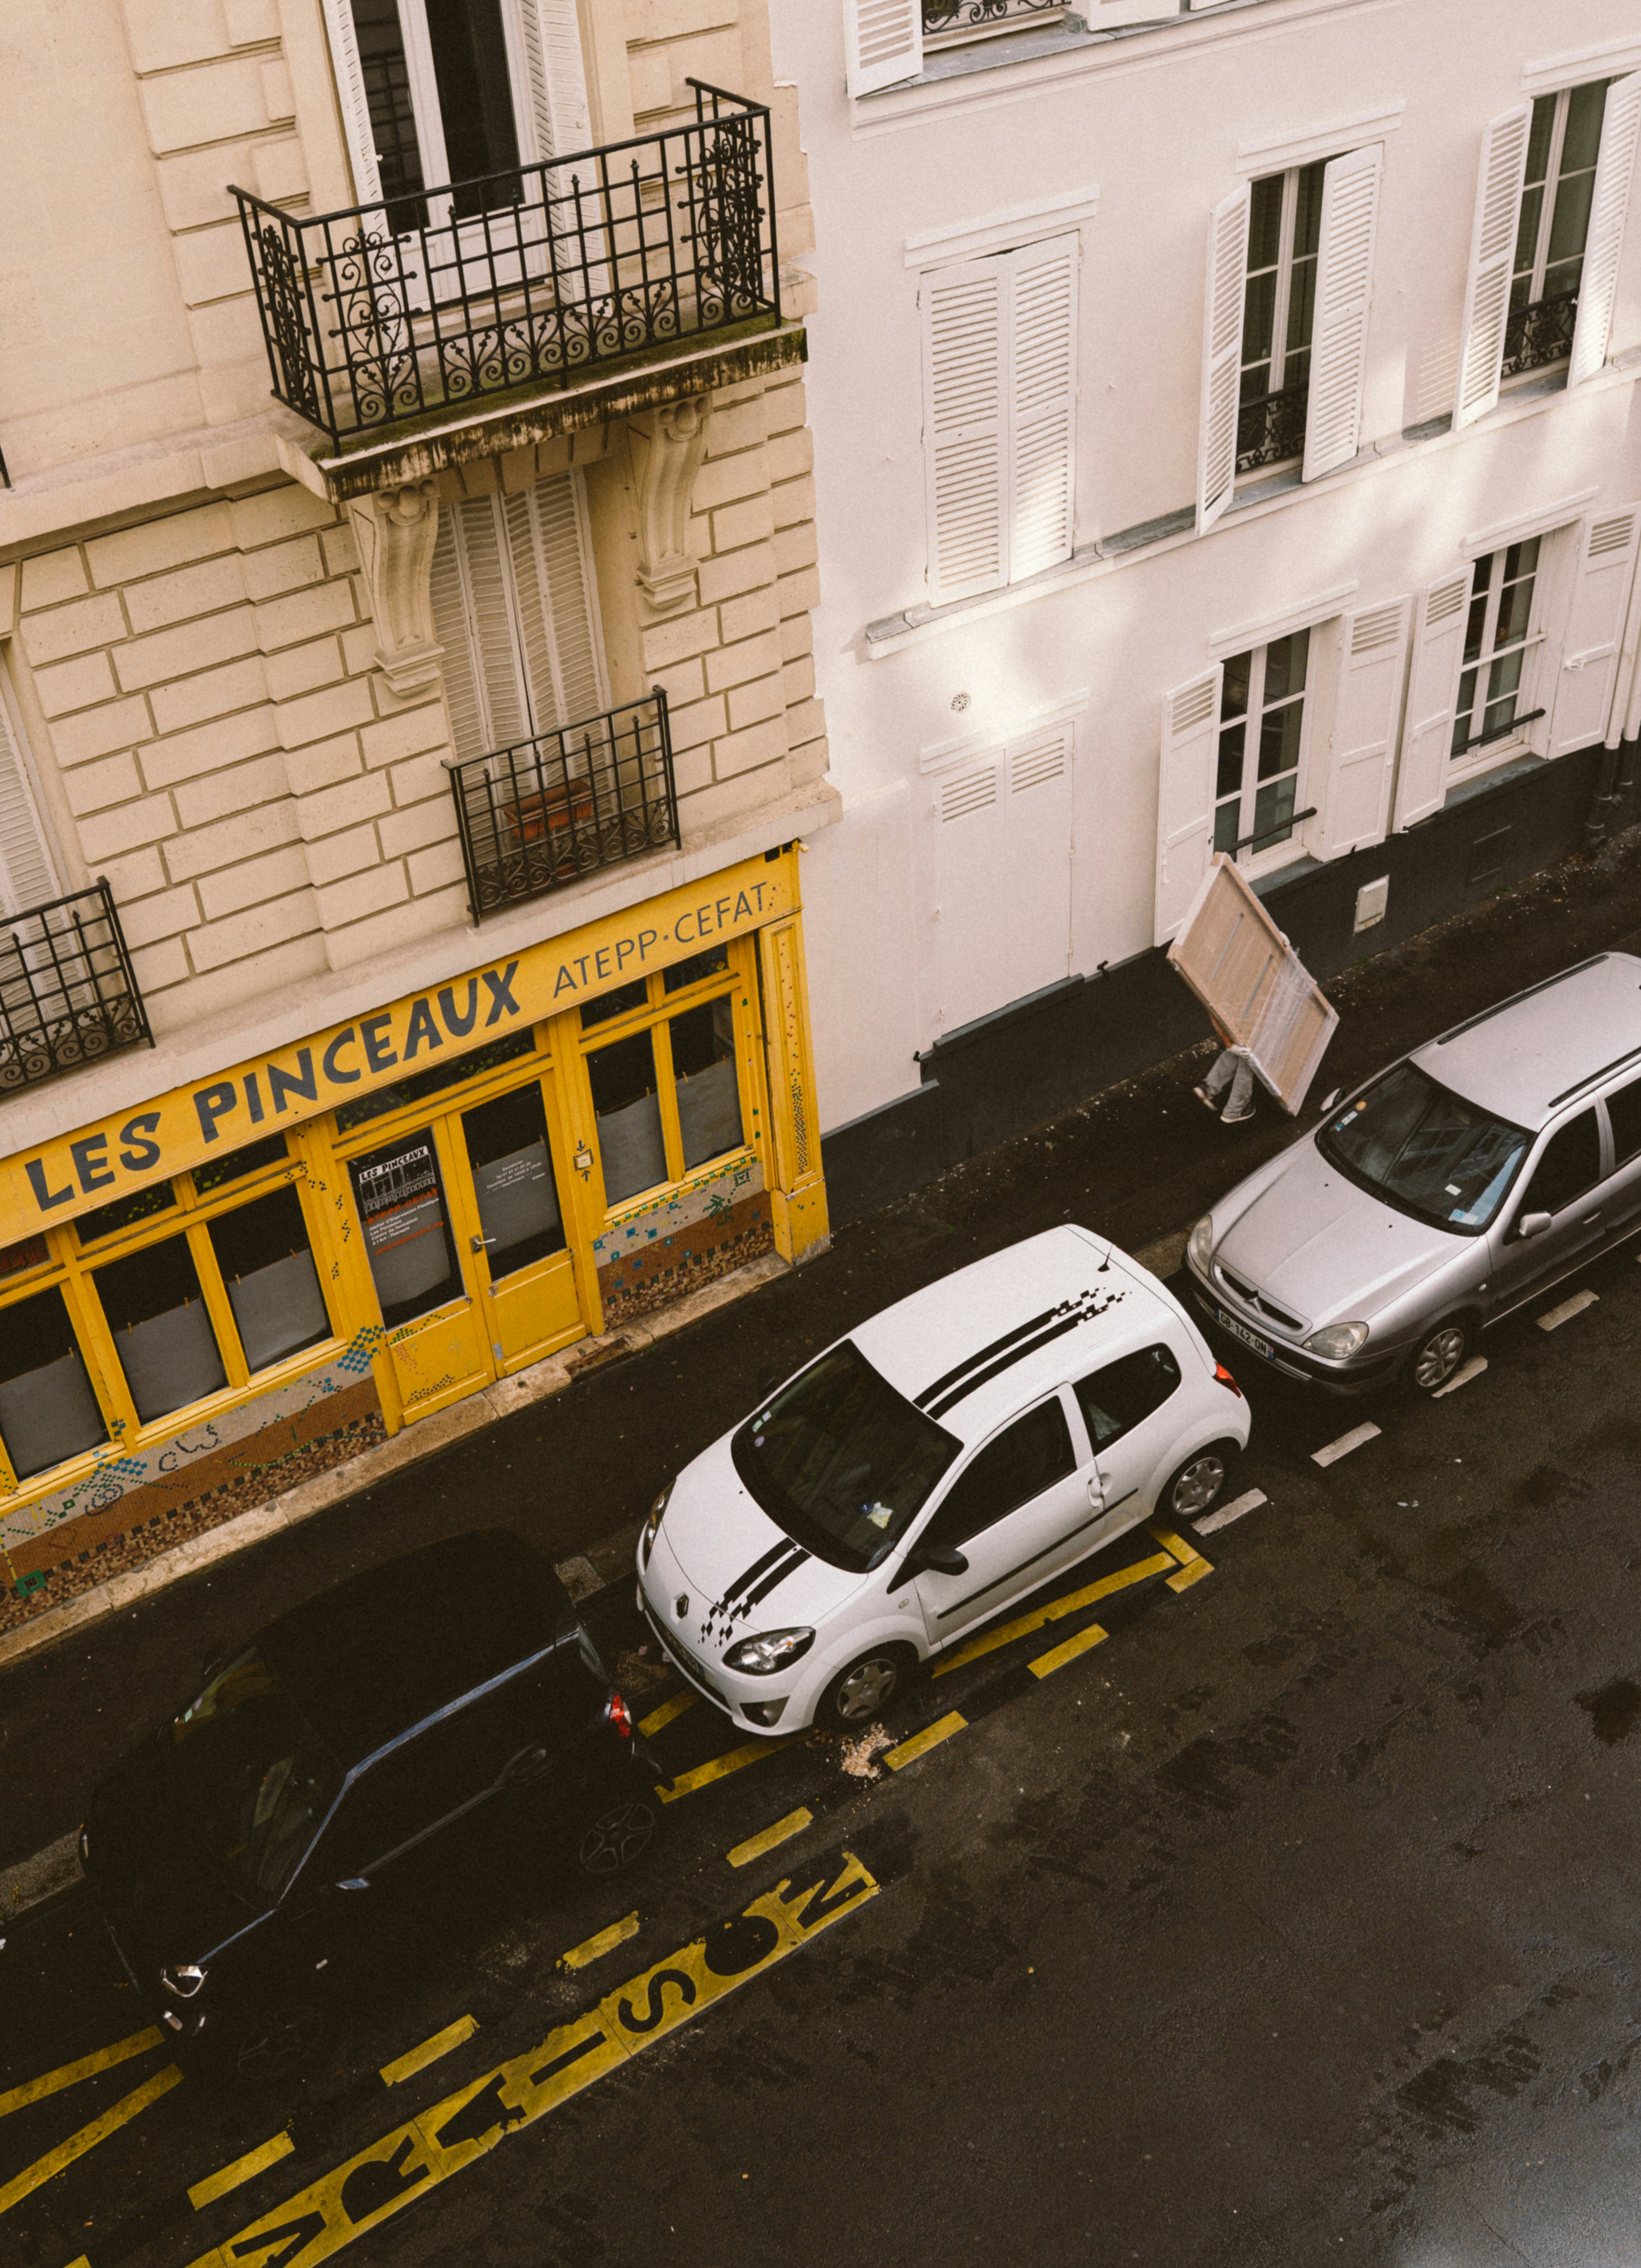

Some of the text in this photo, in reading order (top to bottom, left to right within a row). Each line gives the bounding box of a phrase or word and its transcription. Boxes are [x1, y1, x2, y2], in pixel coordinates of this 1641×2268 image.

[24, 960, 520, 1211] LES PINCEAUX
[361, 1148, 425, 1181] LES PINCEAUX
[487, 1178, 506, 1189] Ouverture
[368, 1187, 438, 1226] ATEPP-CEFAT
[369, 1197, 439, 1231] Atelier d'Expression Plastique
[371, 1231, 387, 1240] Centre
[395, 1218, 418, 1230] formation
[380, 1220, 402, 1231] Pinceaux
